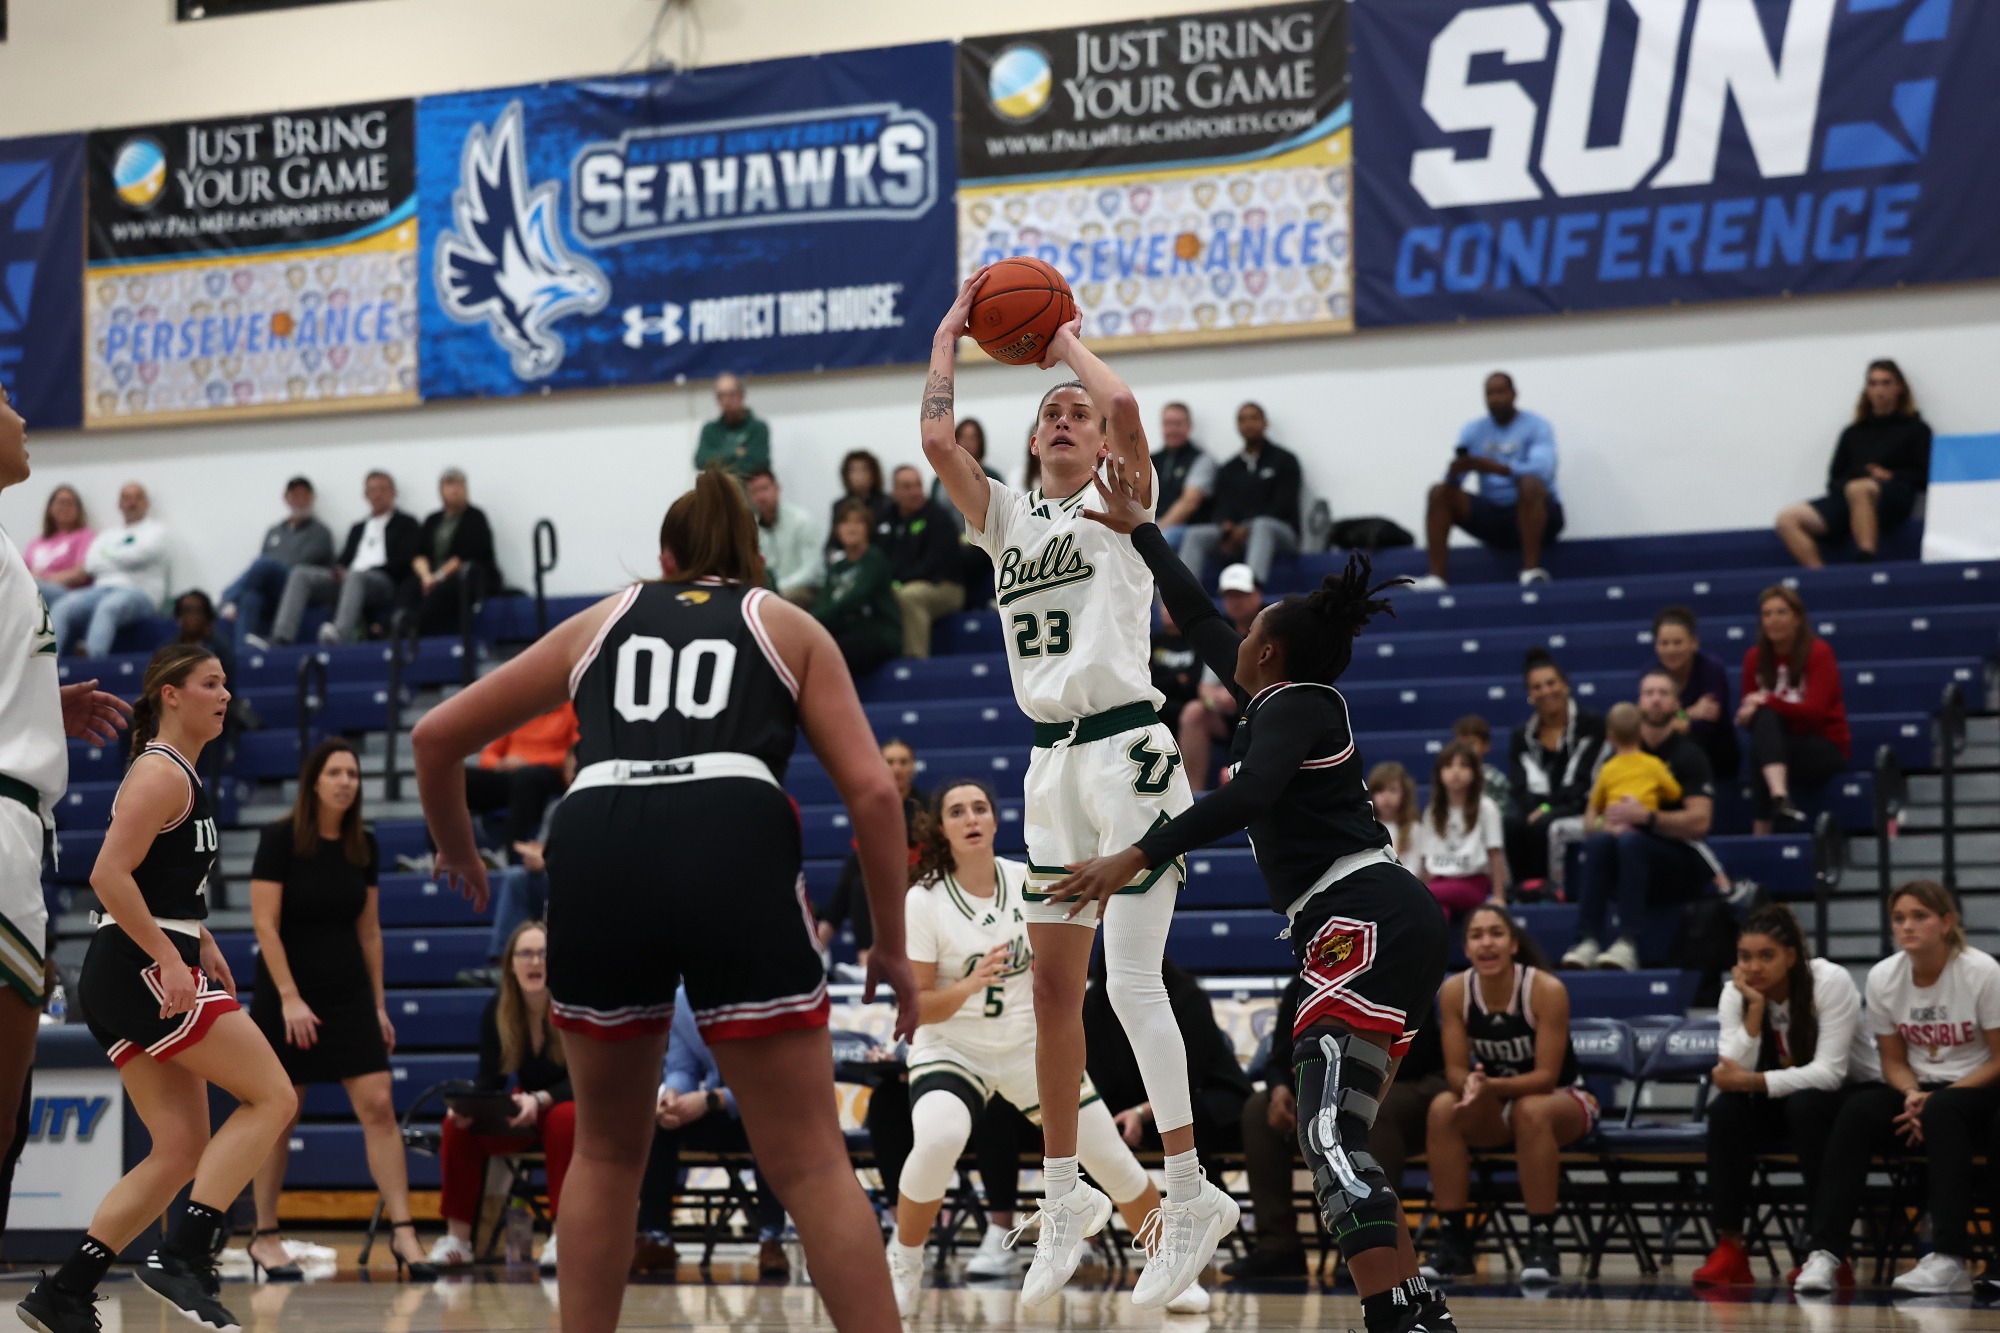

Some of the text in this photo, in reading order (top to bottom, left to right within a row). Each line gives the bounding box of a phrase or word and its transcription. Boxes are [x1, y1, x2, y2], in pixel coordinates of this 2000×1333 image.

[1076, 13, 1314, 82] JUST BRING
[1063, 60, 1315, 121] YOUR GAME
[1409, 0, 1835, 209] SUN
[186, 111, 388, 171] JUST BRING
[176, 153, 388, 210] YOUR GAME
[580, 123, 925, 234] SEAHAWKS
[1394, 183, 1922, 296] CONFERENCE
[689, 294, 776, 345] PROTECT
[779, 290, 825, 337] THIS
[997, 531, 1094, 607] Bulls
[1012, 608, 1072, 659] 23
[614, 633, 737, 722] 00
[983, 985, 1005, 1018] 5
[1896, 1021, 1975, 1048] OSSIBLE
[26, 1096, 112, 1143] ITY
